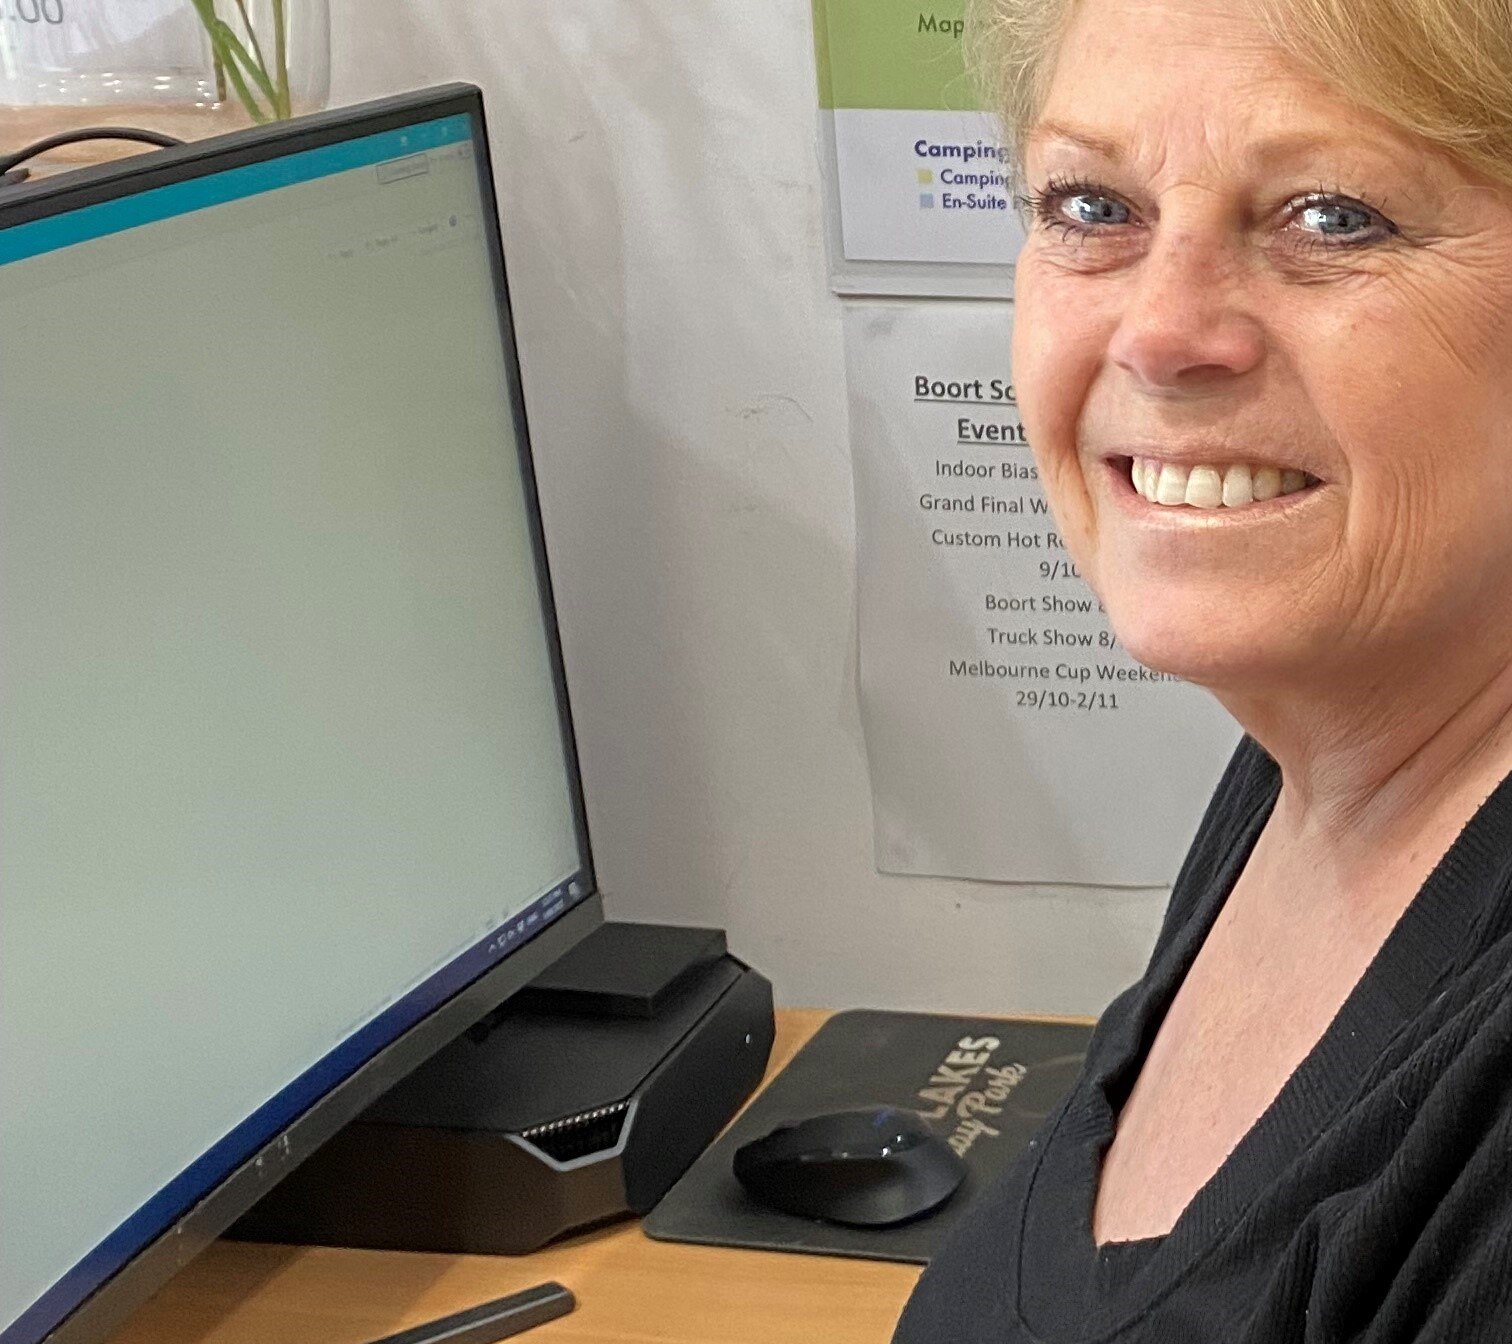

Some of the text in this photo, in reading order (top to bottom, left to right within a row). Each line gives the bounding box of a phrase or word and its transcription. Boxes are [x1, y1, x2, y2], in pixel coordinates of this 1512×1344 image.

[918, 14, 964, 38] Map
[942, 193, 1007, 209] En-Suite
[915, 375, 982, 400] Boort
[935, 460, 1038, 479] Indoor Bias
[919, 494, 975, 513] Grand
[982, 496, 1023, 514] Final
[932, 529, 1001, 547] Custom
[1007, 532, 1040, 548] Hot
[985, 595, 1036, 611] Boort
[1042, 596, 1091, 612] Show
[987, 628, 1092, 646] Truck Show
[949, 661, 1090, 682] Melbourne Cup
[1016, 691, 1118, 710] 29/10-2/11
[916, 1036, 1000, 1118] LAKES
